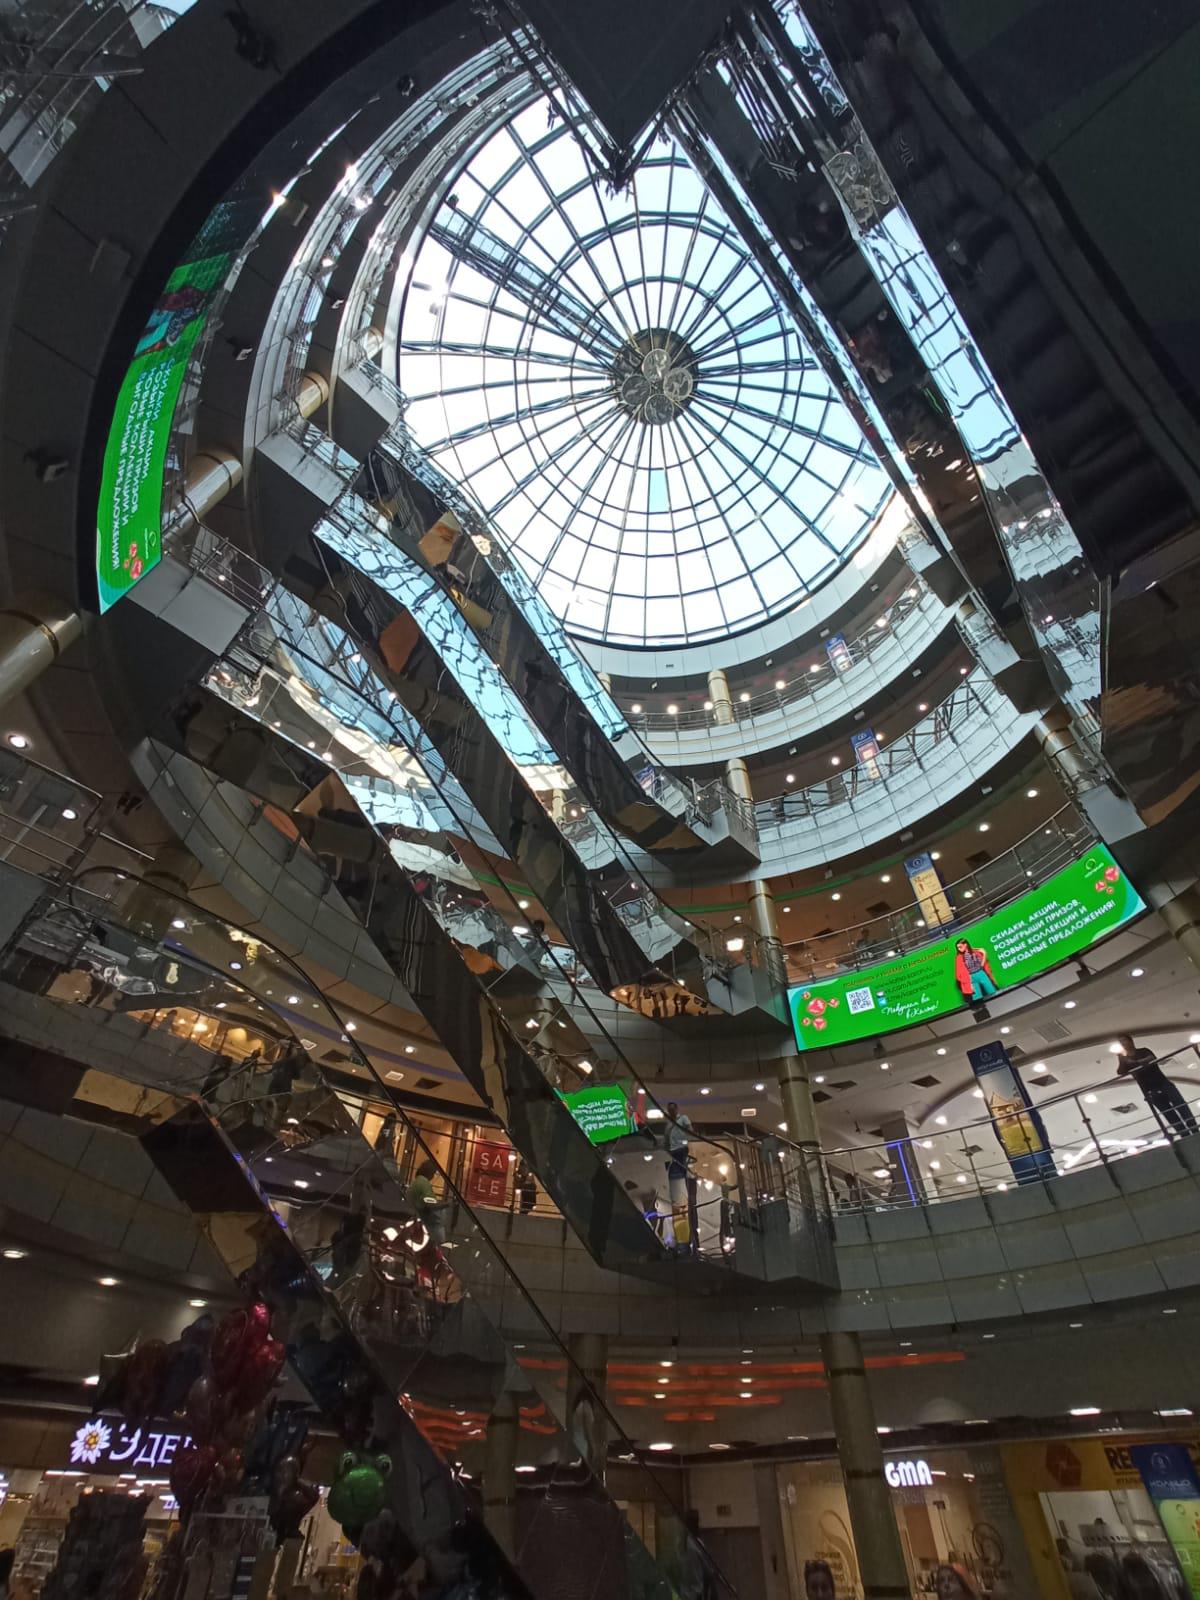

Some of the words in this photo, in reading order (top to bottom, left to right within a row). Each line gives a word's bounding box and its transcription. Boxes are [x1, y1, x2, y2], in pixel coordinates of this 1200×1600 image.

[122, 514, 129, 526] И
[997, 940, 1026, 961] НОВЫЕ
[1027, 912, 1079, 945] КОЛЛЕКЦИИ
[1078, 905, 1088, 917] И
[1001, 941, 1048, 970] ВЫГОДНЫЕ
[109, 1423, 198, 1468] ЭДЕ
